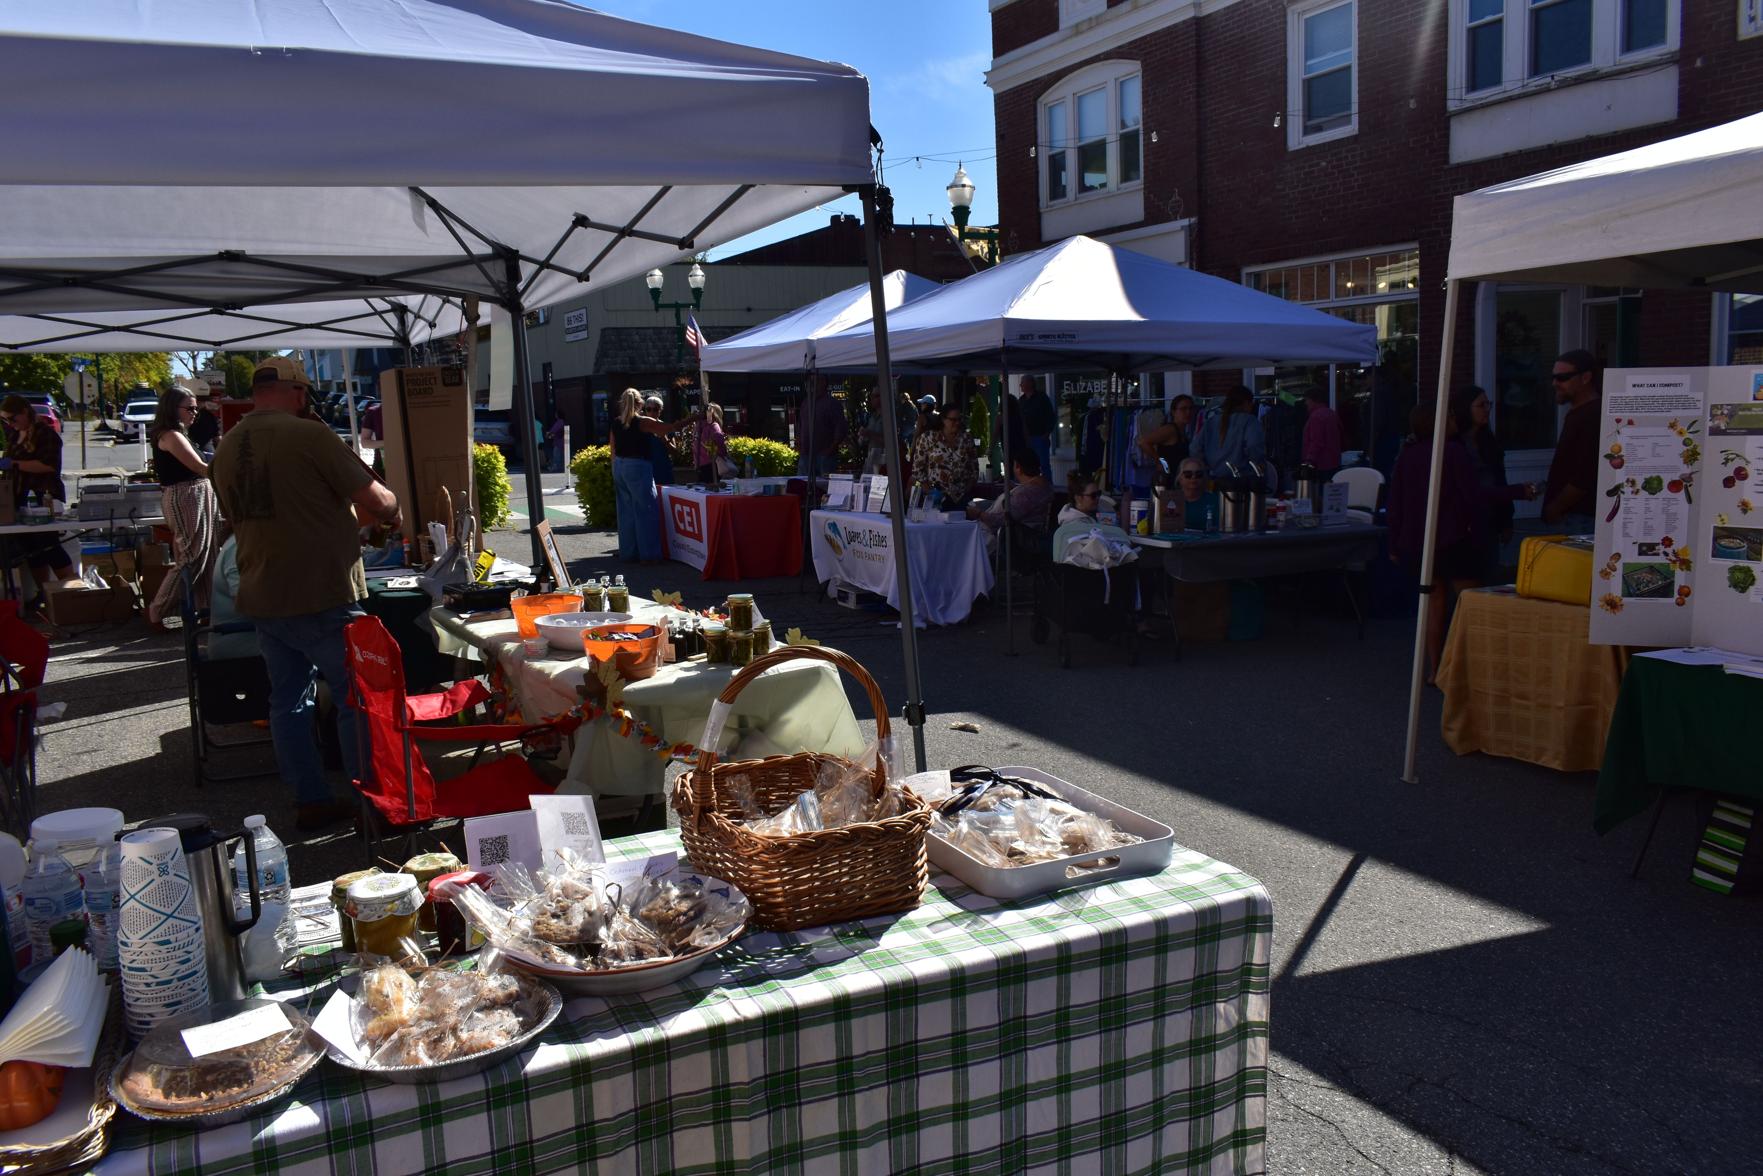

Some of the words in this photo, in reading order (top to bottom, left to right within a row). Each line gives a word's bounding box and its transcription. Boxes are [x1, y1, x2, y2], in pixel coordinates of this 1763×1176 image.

[674, 503, 699, 535] CEI
[843, 526, 862, 545] Loaves
[868, 529, 888, 549] Fishes
